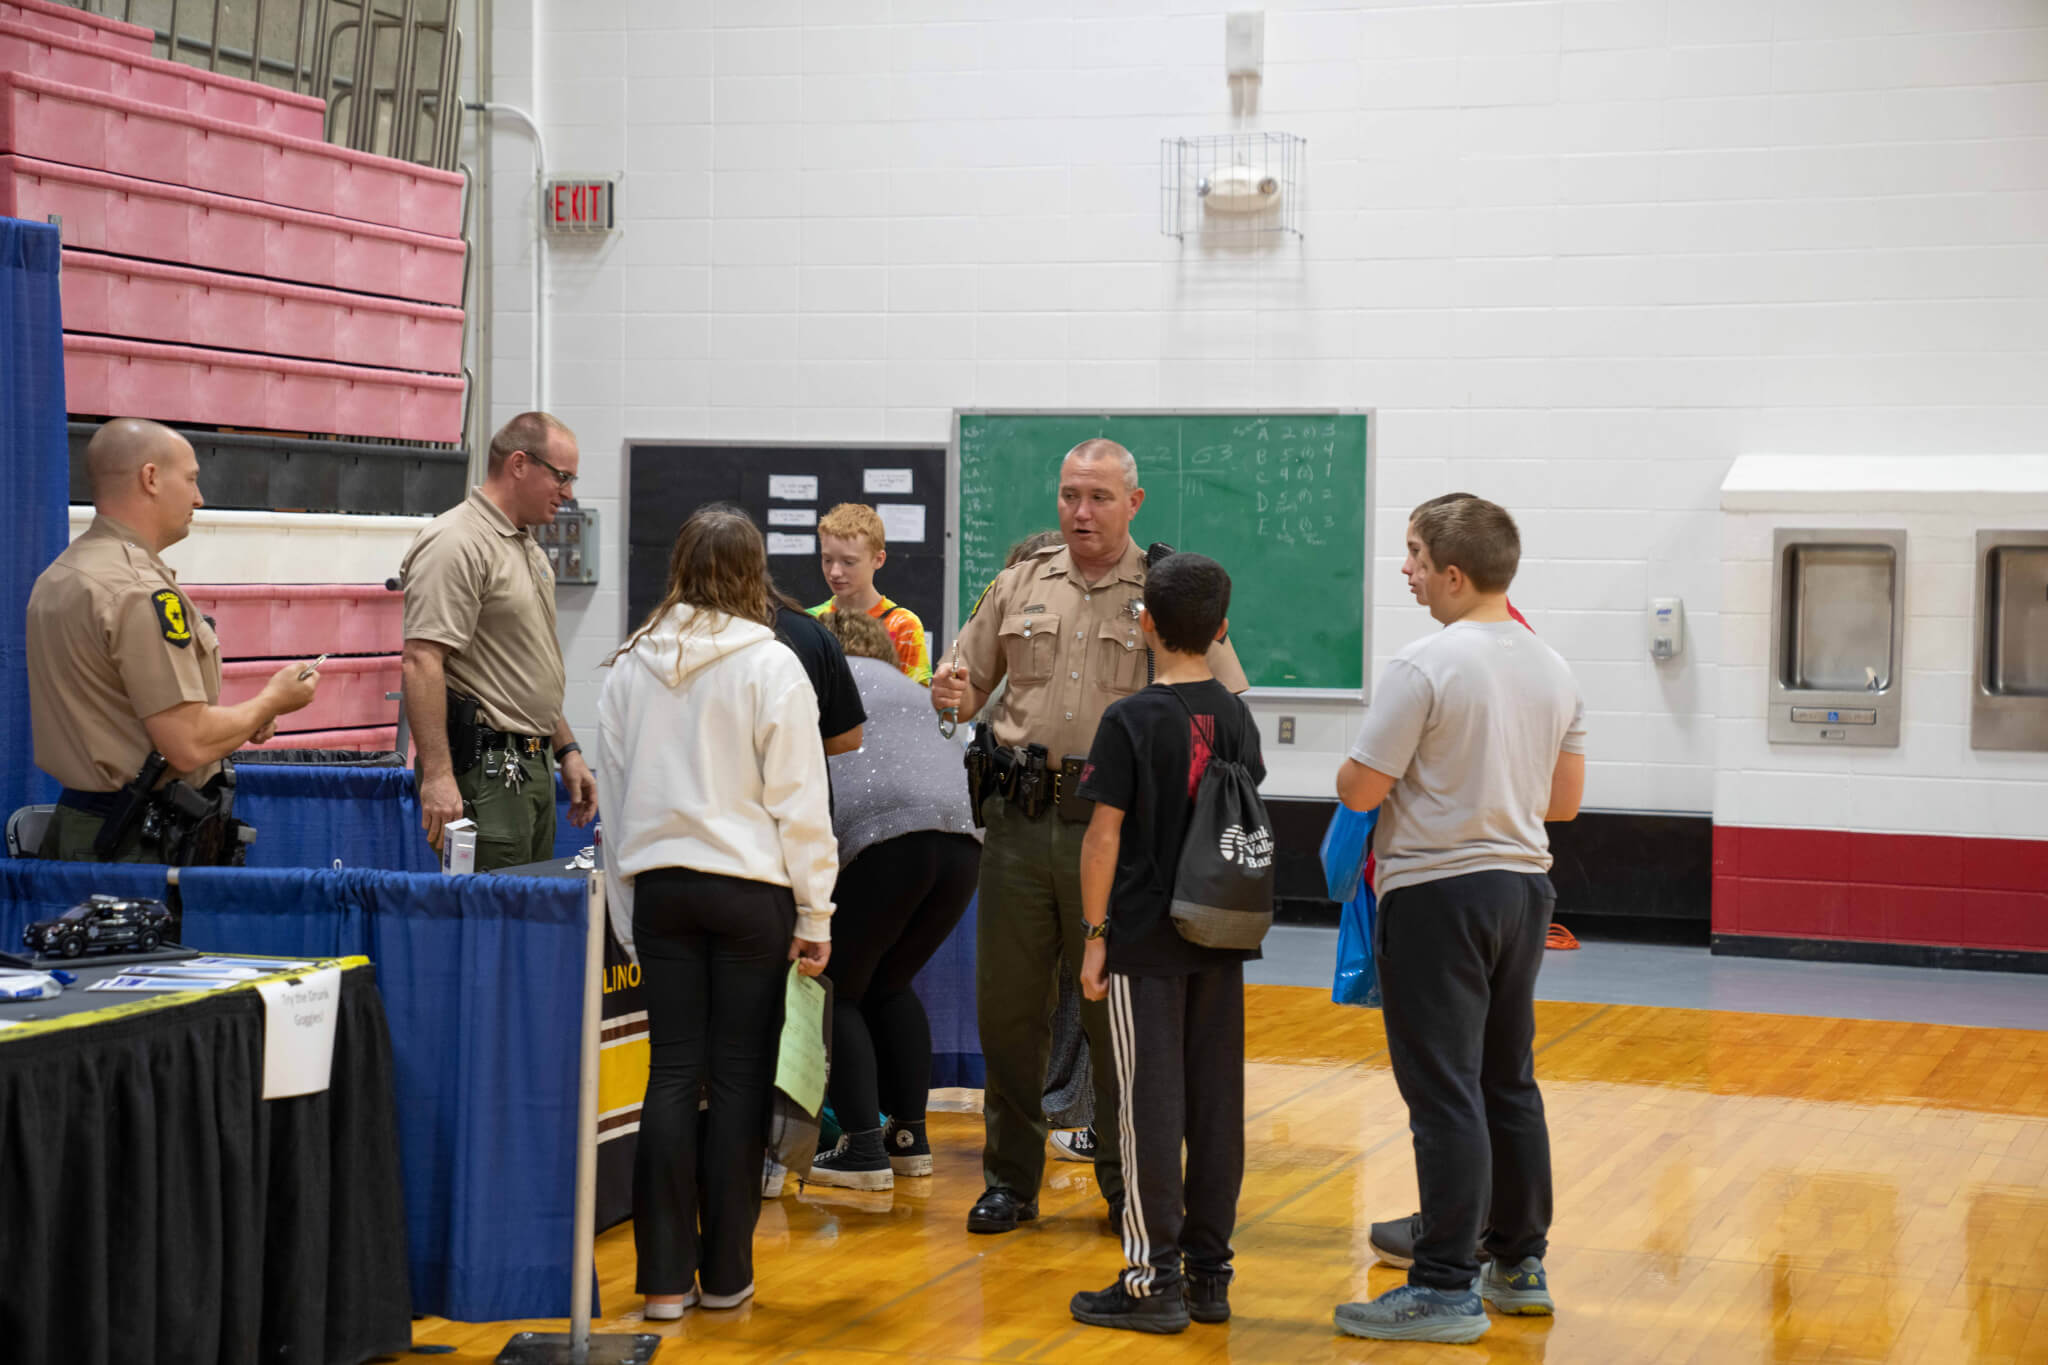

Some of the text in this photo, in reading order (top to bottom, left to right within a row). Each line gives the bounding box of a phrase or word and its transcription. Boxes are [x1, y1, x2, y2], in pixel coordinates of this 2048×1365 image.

[555, 185, 602, 222] EXIT
[1257, 426, 1269, 441] A
[1280, 425, 1297, 439] 2
[1320, 422, 1336, 437] 3
[1256, 446, 1268, 465] B
[1322, 440, 1335, 458] 4
[1257, 490, 1269, 513] D
[1246, 825, 1270, 844] auk
[1244, 839, 1275, 857] Vally
[1245, 855, 1272, 869] Ban
[603, 963, 641, 994] LINO
